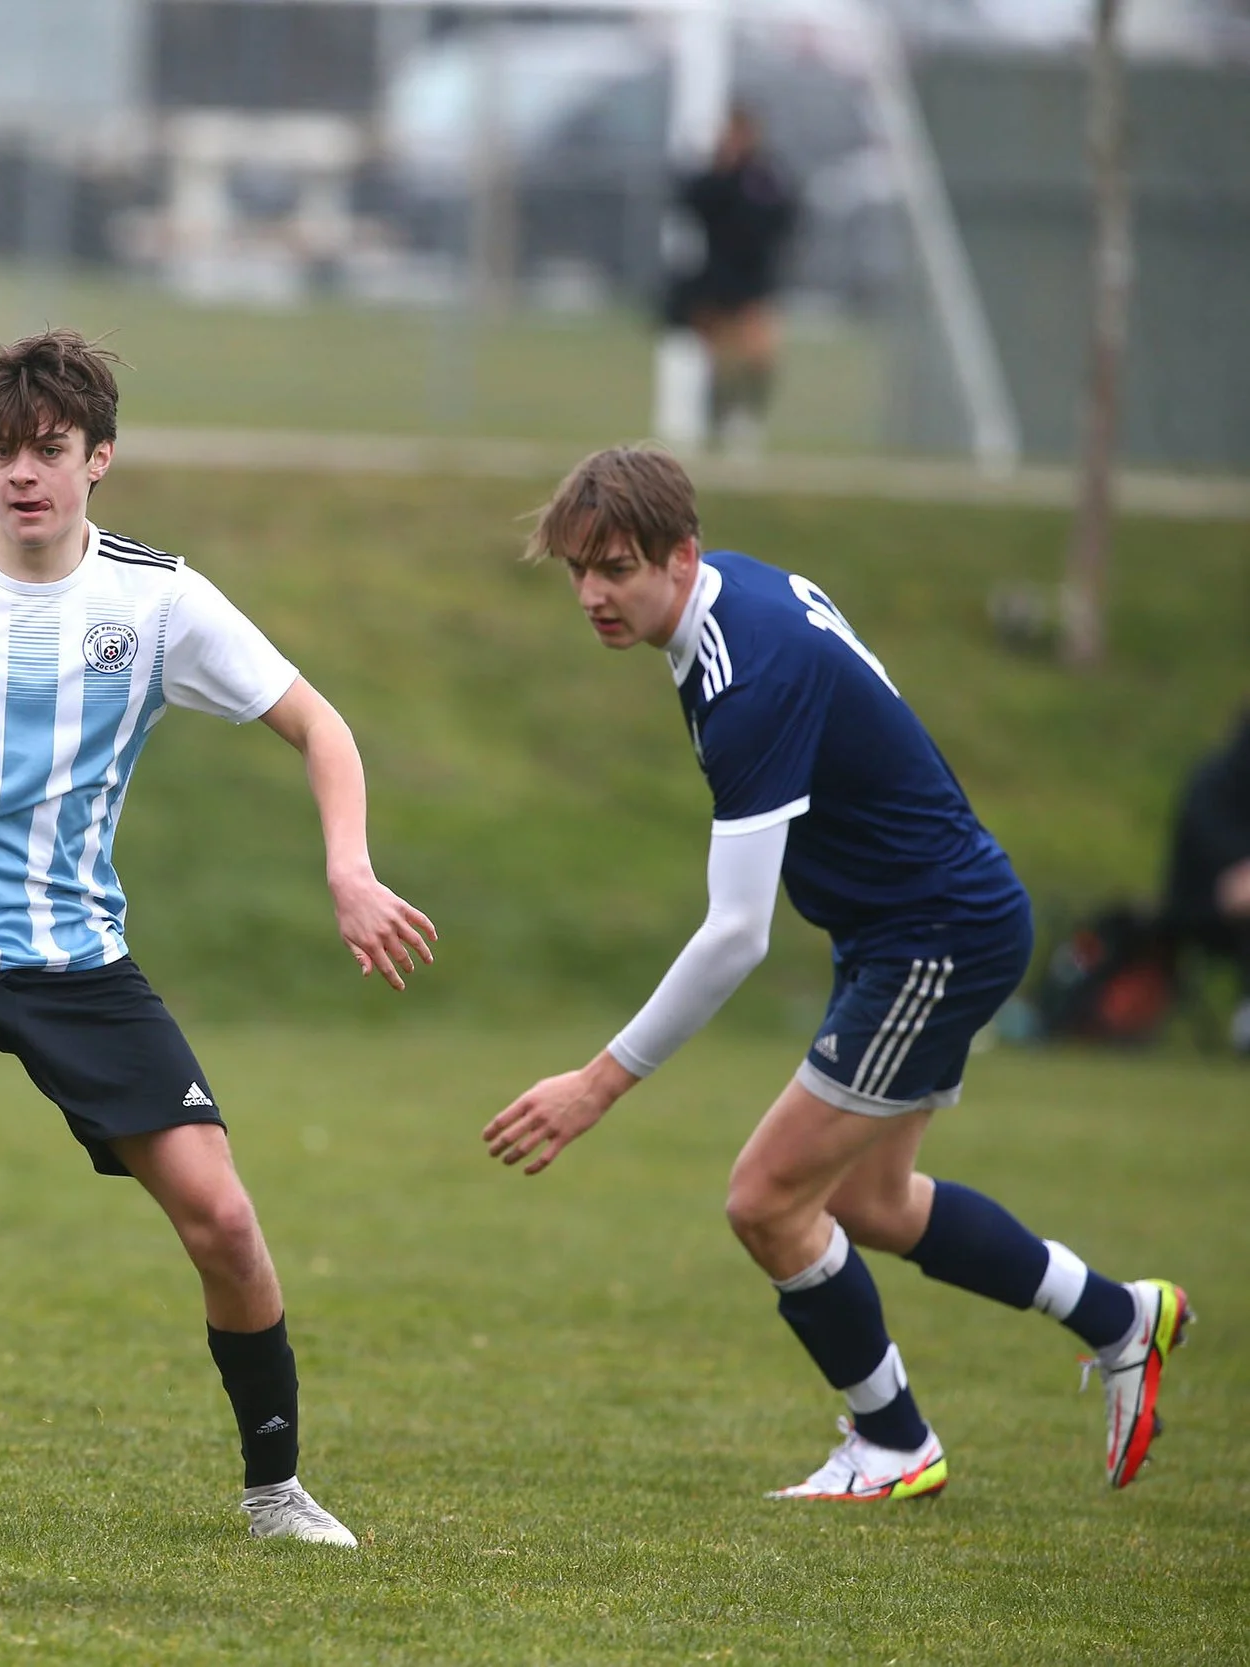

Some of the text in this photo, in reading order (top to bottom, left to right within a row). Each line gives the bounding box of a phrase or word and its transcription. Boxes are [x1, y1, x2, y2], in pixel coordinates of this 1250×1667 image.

[87, 626, 135, 644] NEW FRONTIER
[95, 661, 124, 671] SOCCER
